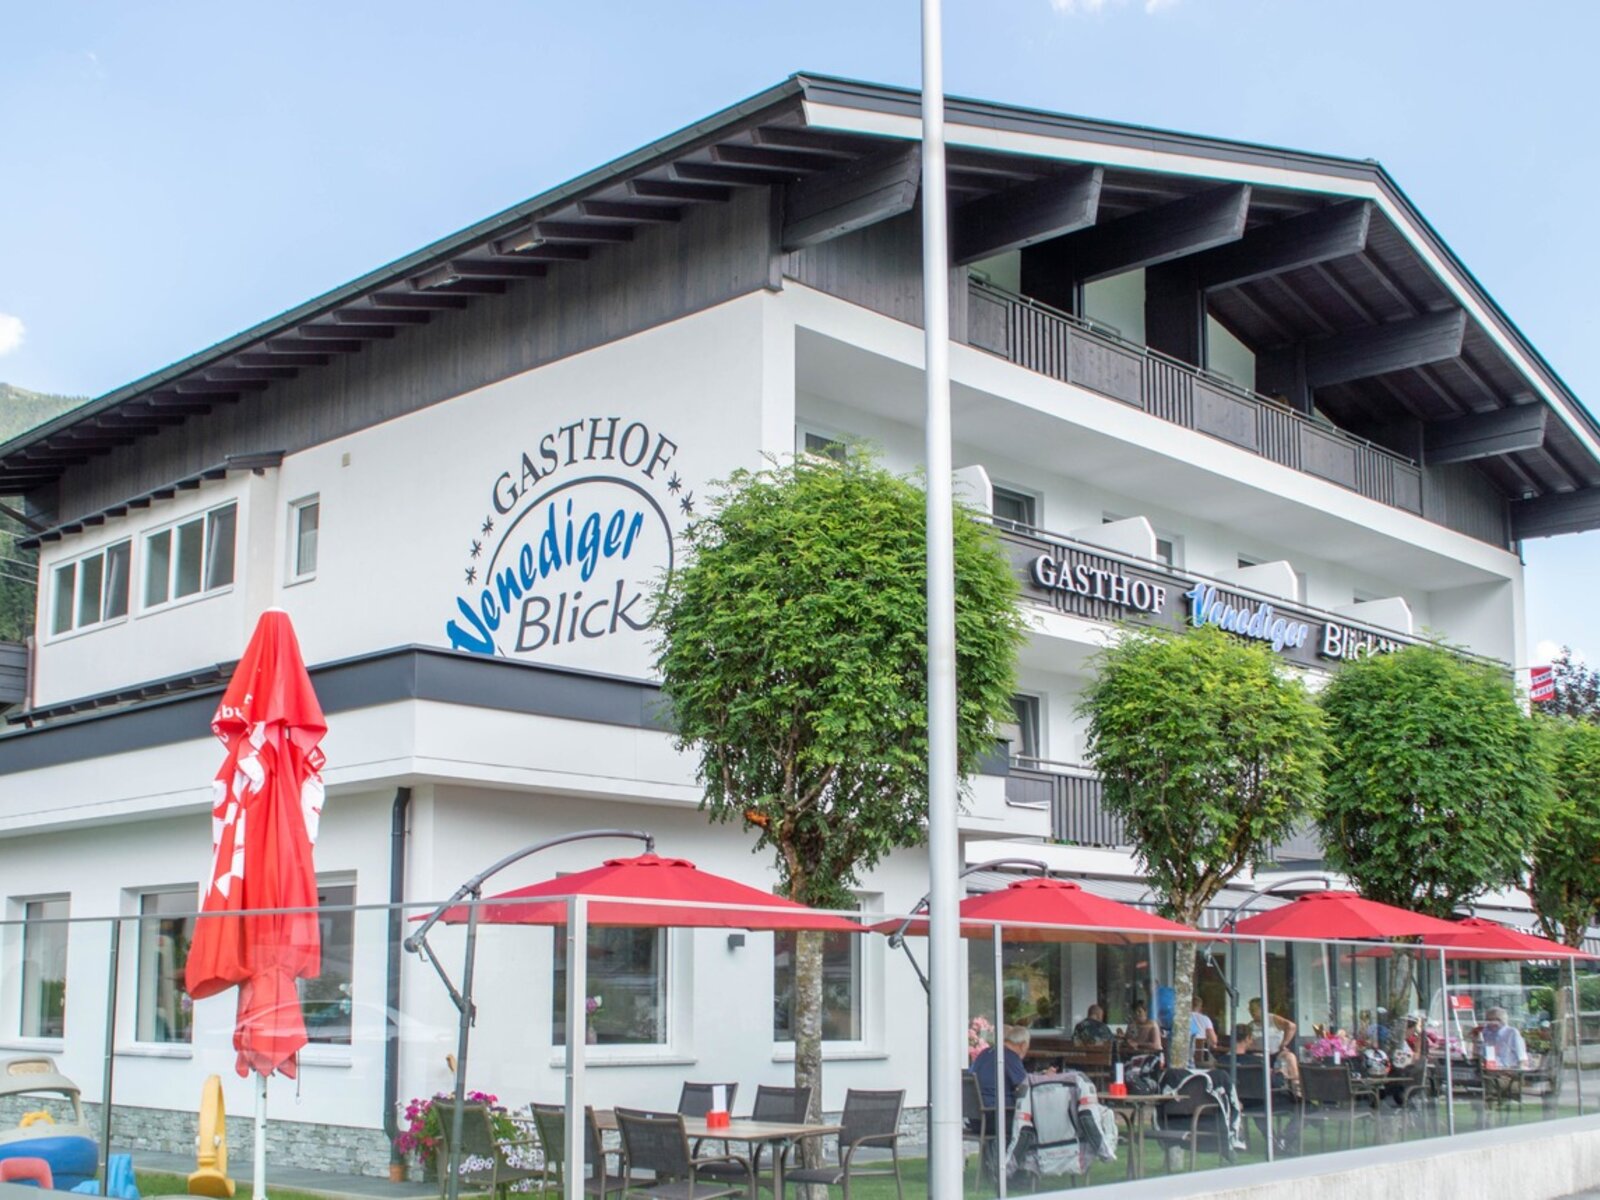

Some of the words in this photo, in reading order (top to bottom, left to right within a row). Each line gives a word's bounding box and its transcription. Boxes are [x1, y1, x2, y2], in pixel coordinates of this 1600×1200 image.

[492, 417, 678, 515] GASTHOF
[446, 498, 644, 657] Venediger
[514, 579, 653, 653] Blick
[1035, 554, 1167, 614] GASTHOF
[1184, 583, 1308, 652] Venediger
